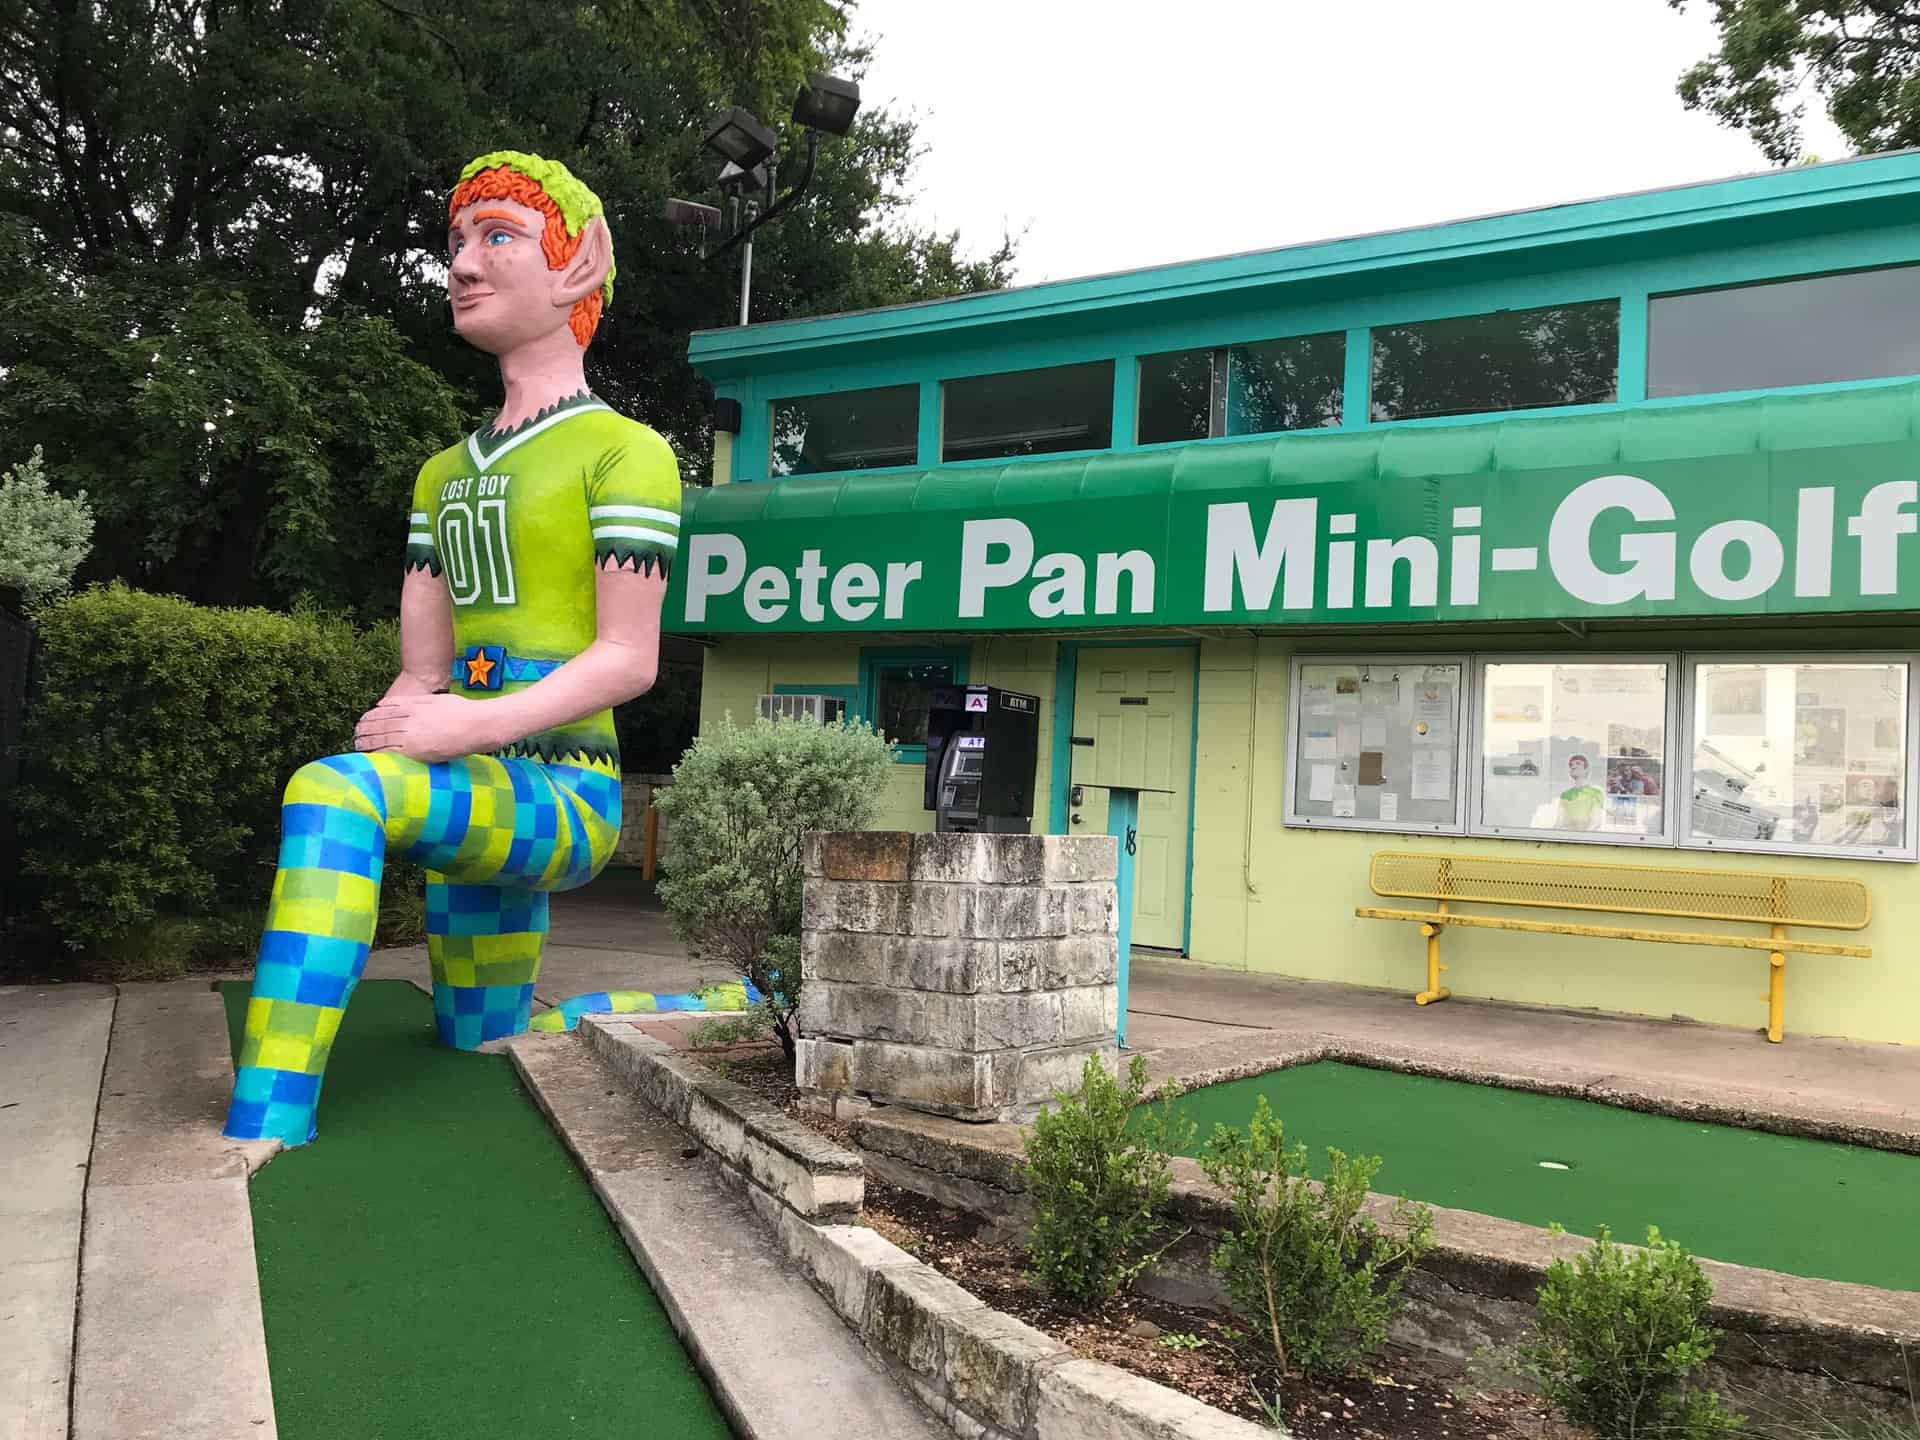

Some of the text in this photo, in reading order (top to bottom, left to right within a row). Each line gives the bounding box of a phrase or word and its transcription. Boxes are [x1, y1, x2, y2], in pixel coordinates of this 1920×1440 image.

[441, 475, 511, 500] LOST BOY
[437, 500, 516, 606] 01
[684, 475, 1918, 624] Peter Pan Mini-Golf
[1009, 697, 1027, 709] ATM
[1125, 824, 1137, 857] 18
